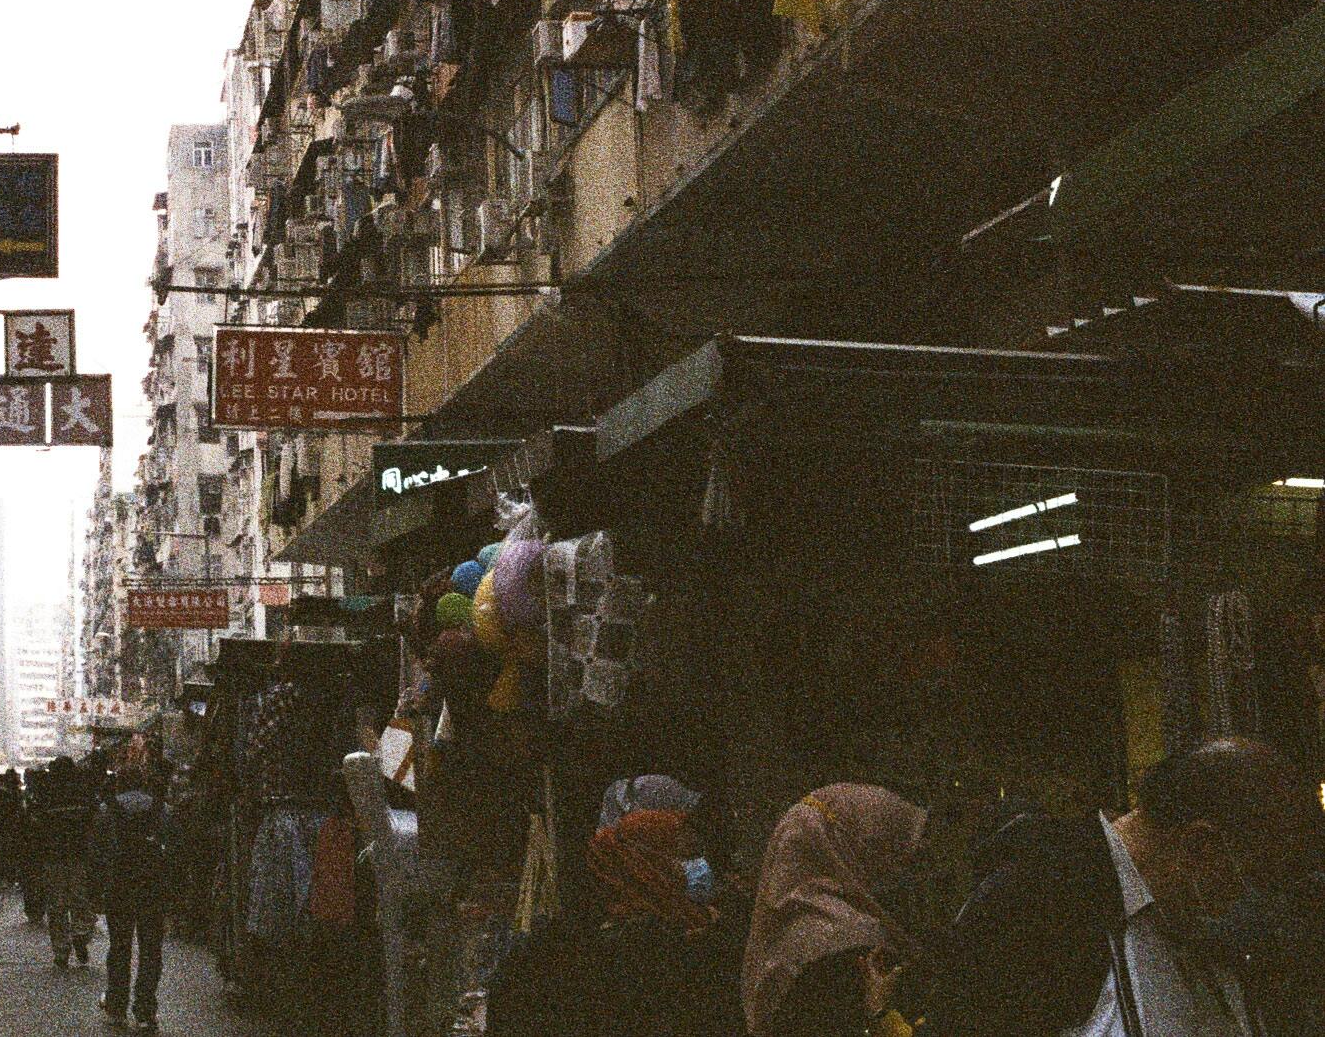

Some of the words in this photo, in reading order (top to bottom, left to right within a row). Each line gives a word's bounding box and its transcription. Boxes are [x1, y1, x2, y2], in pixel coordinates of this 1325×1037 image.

[219, 384, 256, 399] LEE
[267, 386, 318, 401] STAR
[332, 387, 393, 403] HOTEL
